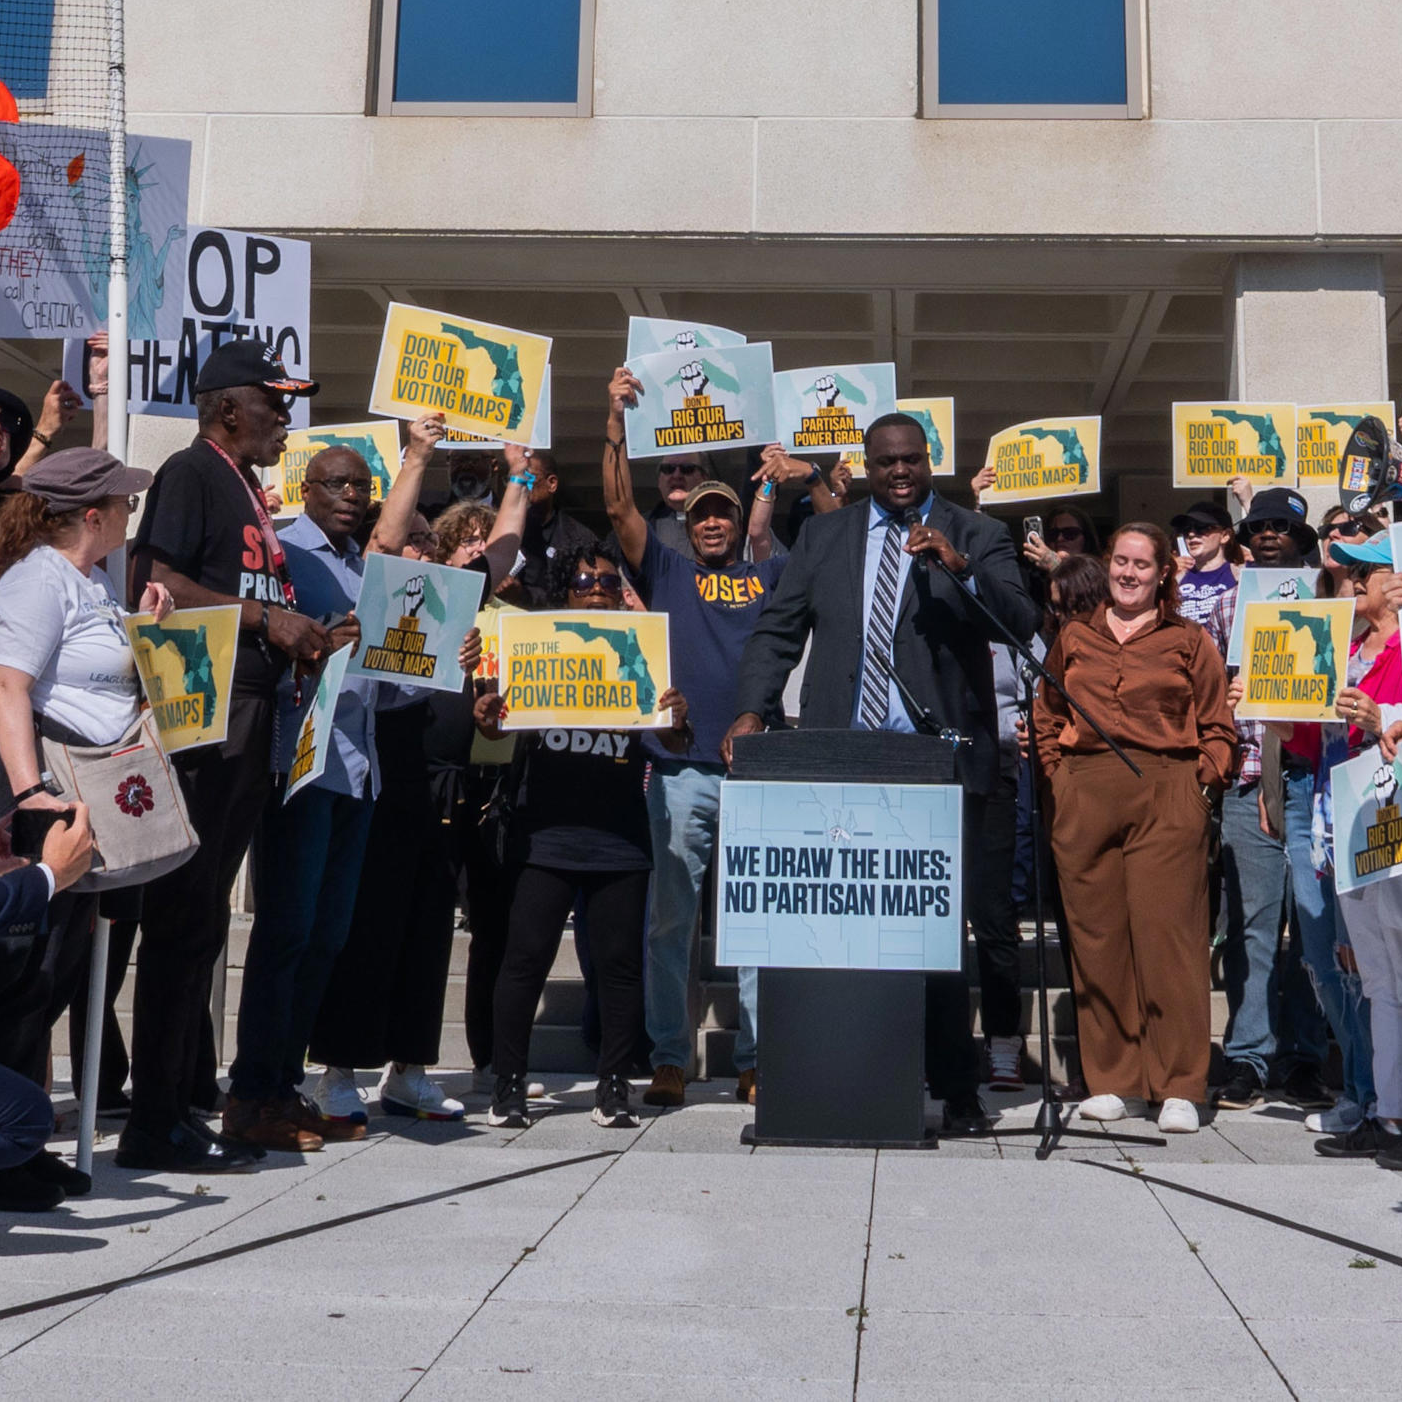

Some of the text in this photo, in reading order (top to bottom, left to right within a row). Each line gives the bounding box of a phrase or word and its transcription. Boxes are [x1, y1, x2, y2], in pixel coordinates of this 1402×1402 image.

[188, 230, 281, 319] OP
[4, 278, 25, 301] call
[21, 301, 84, 330] CHEATING
[403, 334, 457, 364] DON'T
[399, 356, 465, 389] RIG OUR
[398, 378, 508, 423] VOTING MAPS
[685, 396, 709, 407] DON'T
[672, 407, 725, 427] RIG OUR
[802, 416, 855, 431] PARTISAN
[656, 422, 744, 447] VOTING MAPS
[795, 430, 863, 446] POWER GRAB
[1189, 423, 1226, 440] DON'T
[997, 440, 1033, 459] DON'T
[1189, 440, 1236, 456] RIG OUR
[1311, 441, 1336, 457] OUR
[996, 455, 1042, 473] RIG OUR
[1189, 457, 1273, 474] VOTING MAPS
[996, 467, 1077, 490] VOTING MAPS
[385, 629, 425, 653] RIG OUR
[512, 643, 538, 656] STOP
[541, 641, 559, 654] THE
[1254, 630, 1289, 652] DON'T
[366, 649, 435, 677] VOTING MAPS
[512, 658, 603, 682] PARTISAN
[1251, 654, 1295, 675] RIG OUR
[511, 684, 632, 708] POWER GRAB
[1249, 678, 1325, 701] VOTING MAPS
[165, 697, 200, 728] MAPS
[1368, 825, 1385, 847] RIG
[726, 846, 951, 881] WE DRAW THE LINES:
[1356, 846, 1392, 876] VOTING
[725, 881, 950, 918] NO PARTISAN MAPS
